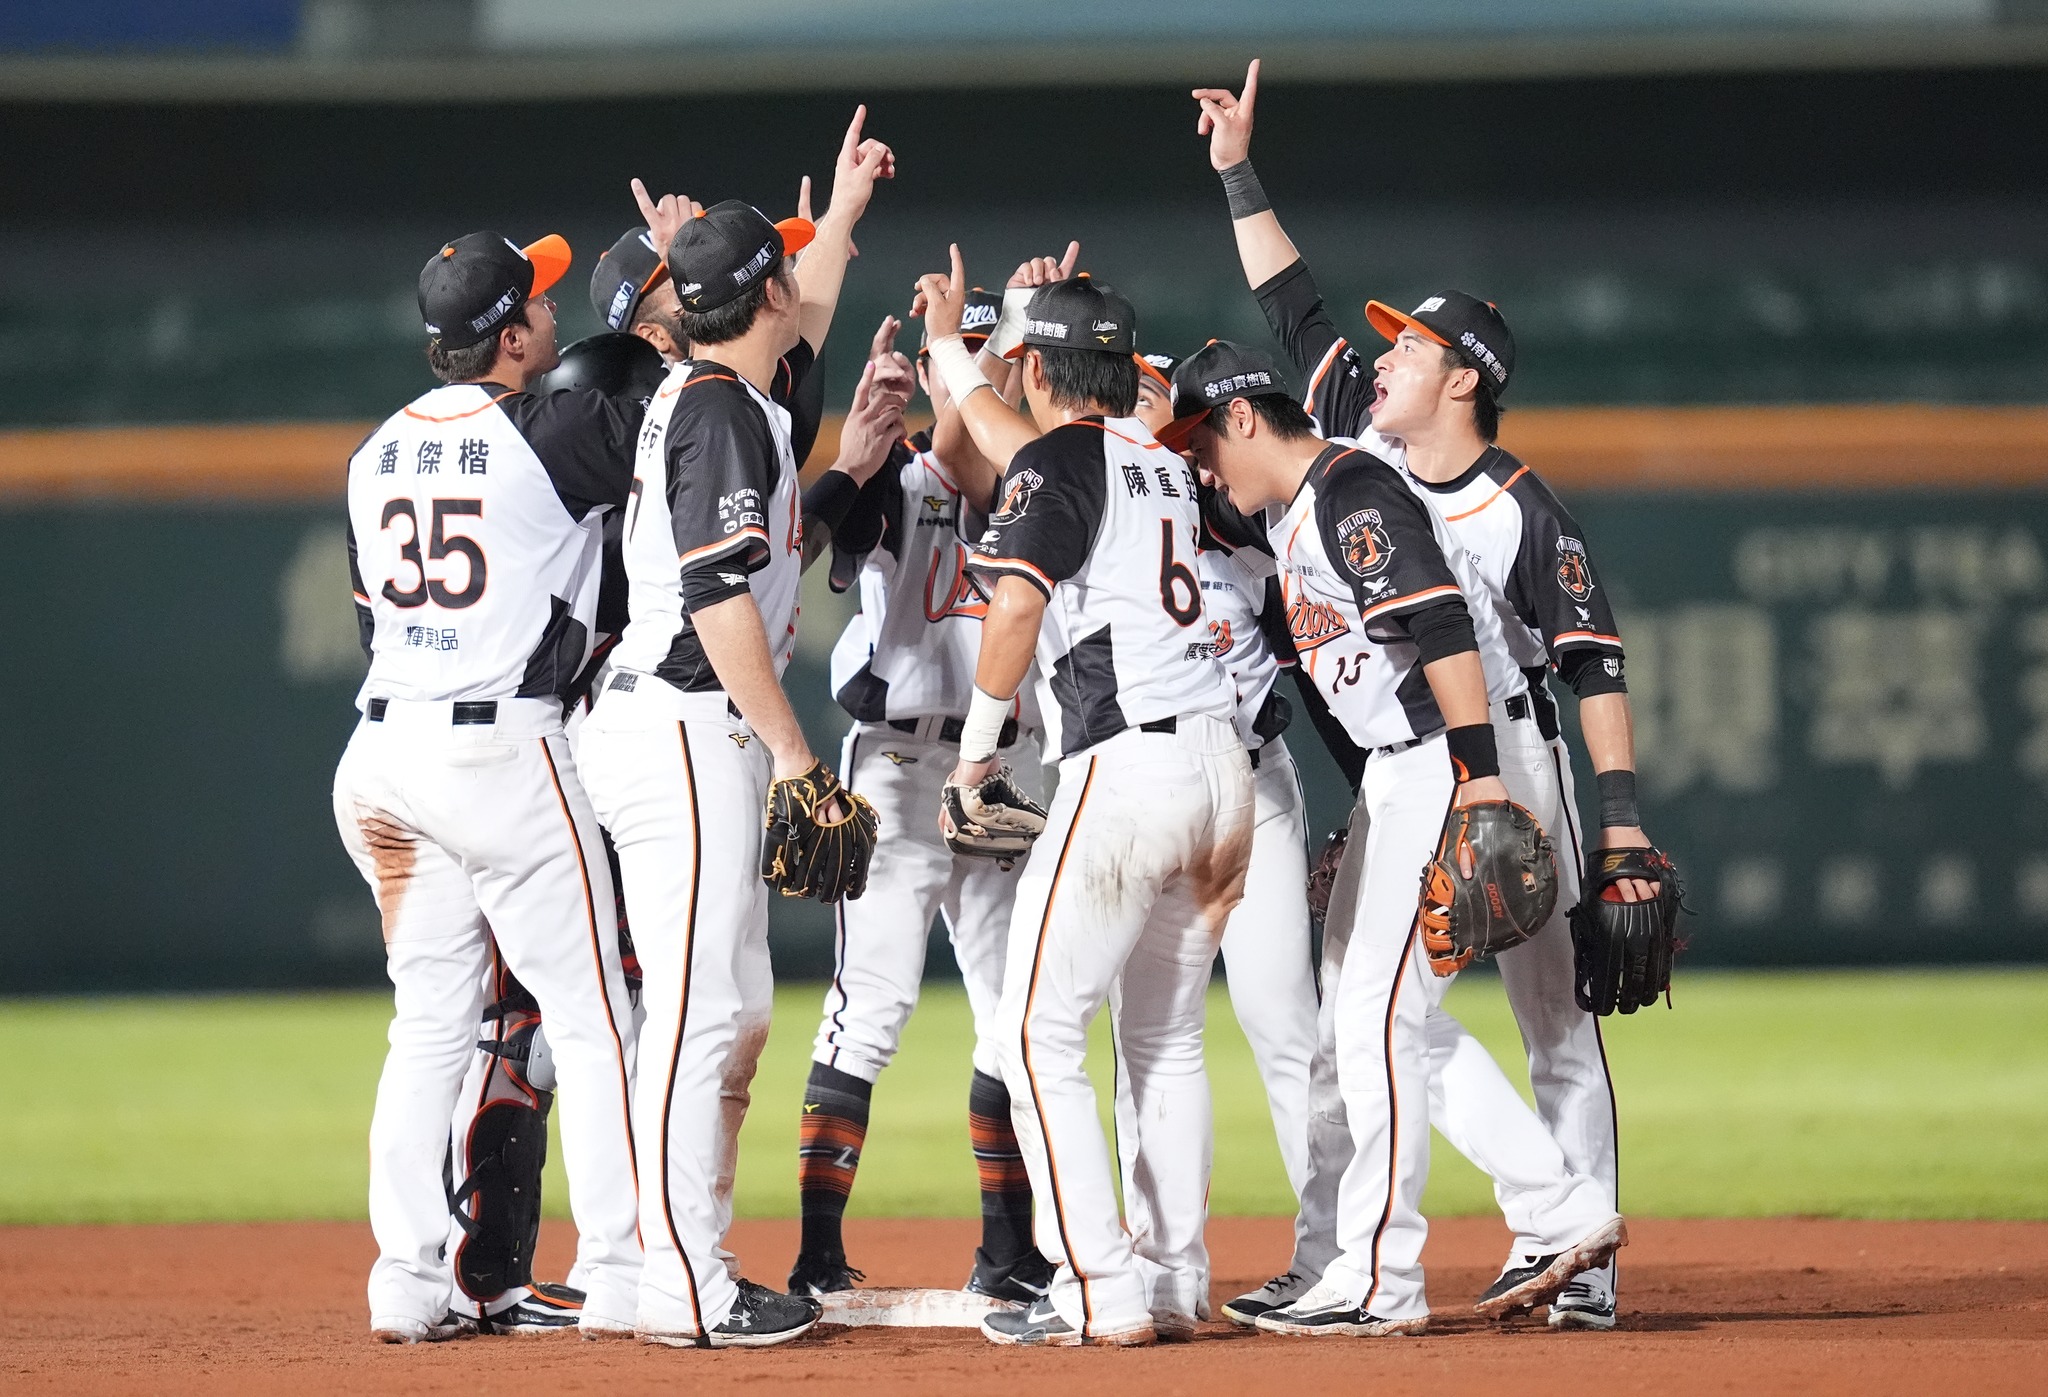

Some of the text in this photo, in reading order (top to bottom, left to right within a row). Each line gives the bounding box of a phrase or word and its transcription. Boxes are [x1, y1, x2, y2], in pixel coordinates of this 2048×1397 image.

[1218, 371, 1272, 394] 南寶樹脂
[375, 438, 489, 476] 潘傑楷
[719, 498, 763, 520] 建大輪
[379, 496, 489, 610] 35
